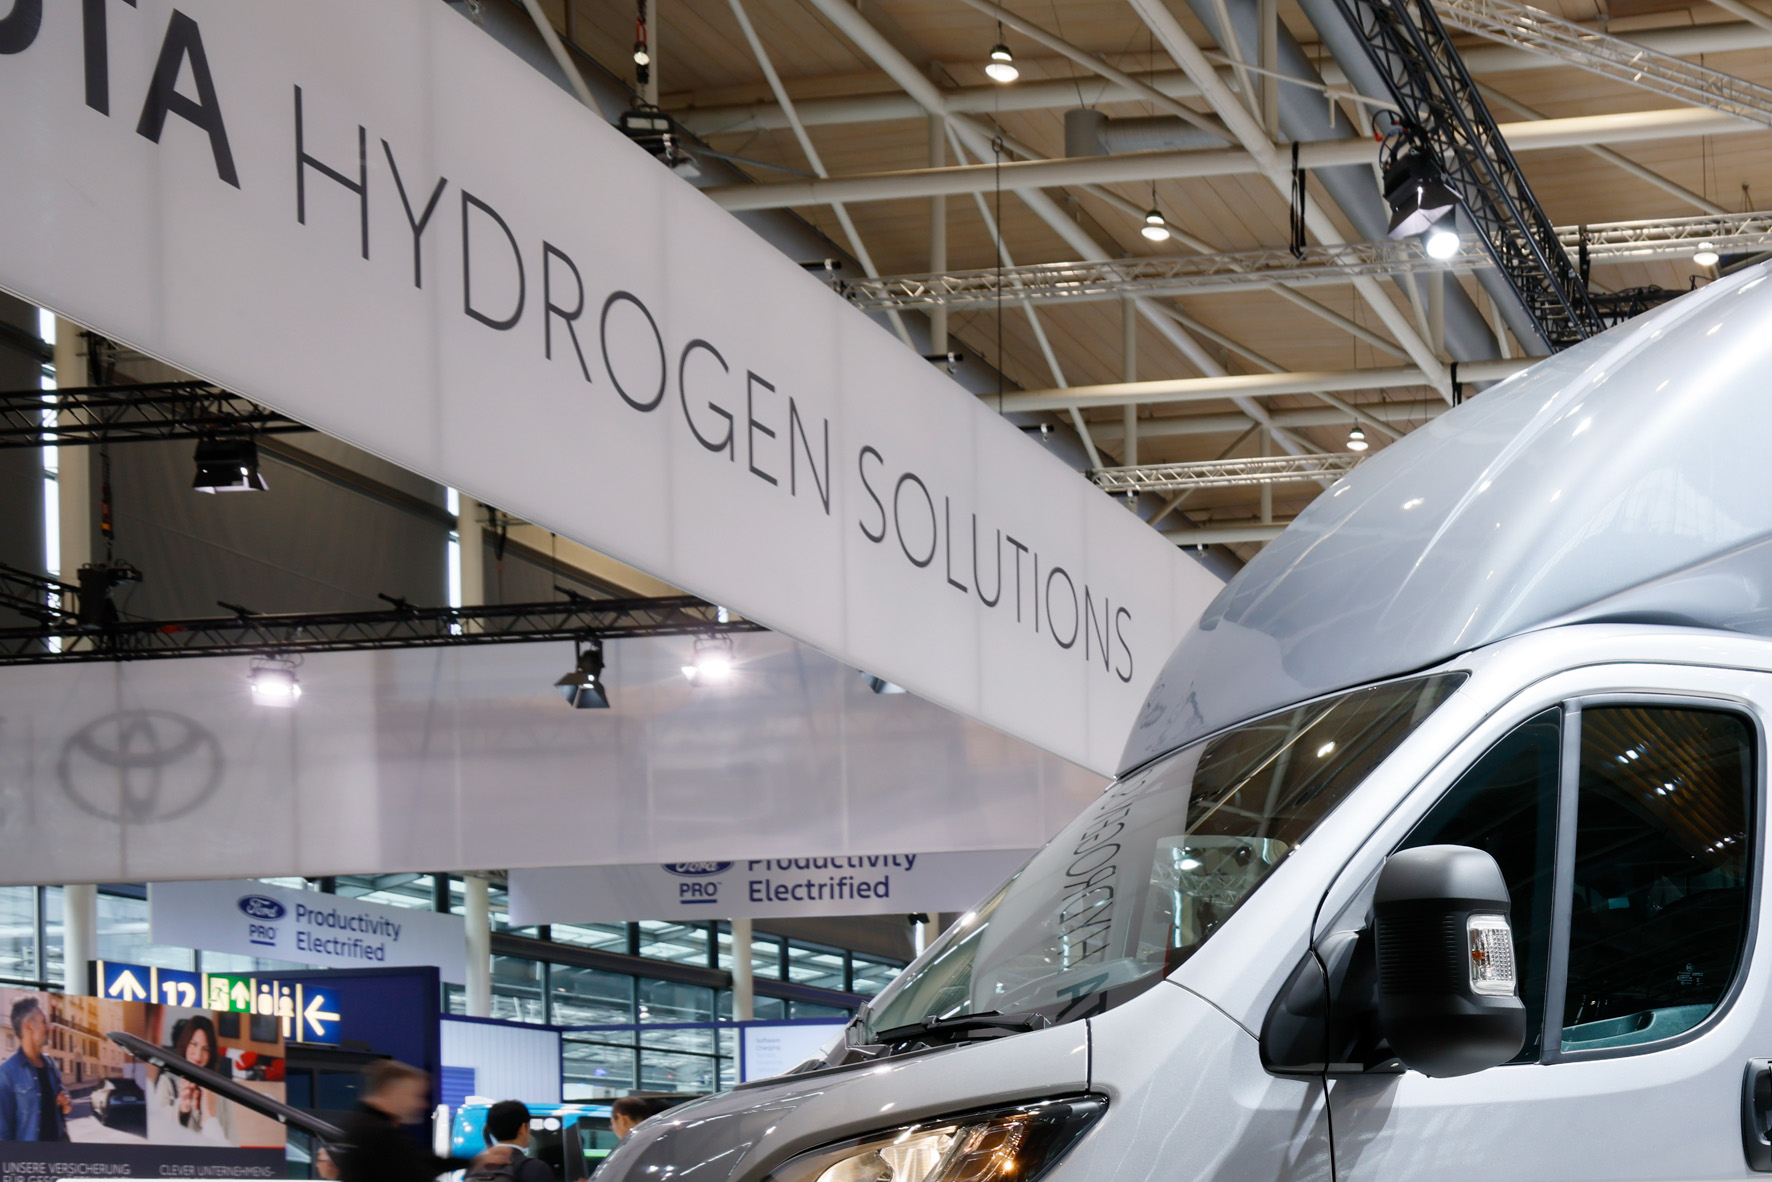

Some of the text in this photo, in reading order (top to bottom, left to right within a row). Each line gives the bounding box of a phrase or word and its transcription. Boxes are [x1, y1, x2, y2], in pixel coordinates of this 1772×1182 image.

[0, 0, 1133, 683] TA HYDROGEN SOLUTIONS
[680, 882, 718, 898] PRO
[749, 875, 890, 903] Electrified
[249, 924, 277, 941] PRO
[295, 903, 402, 942] Productivity
[296, 931, 386, 962] Electrified
[162, 980, 197, 1008] 12
[2, 1161, 131, 1176] UNSERE VERSICHERUNG
[159, 1164, 196, 1177] CLEVER
